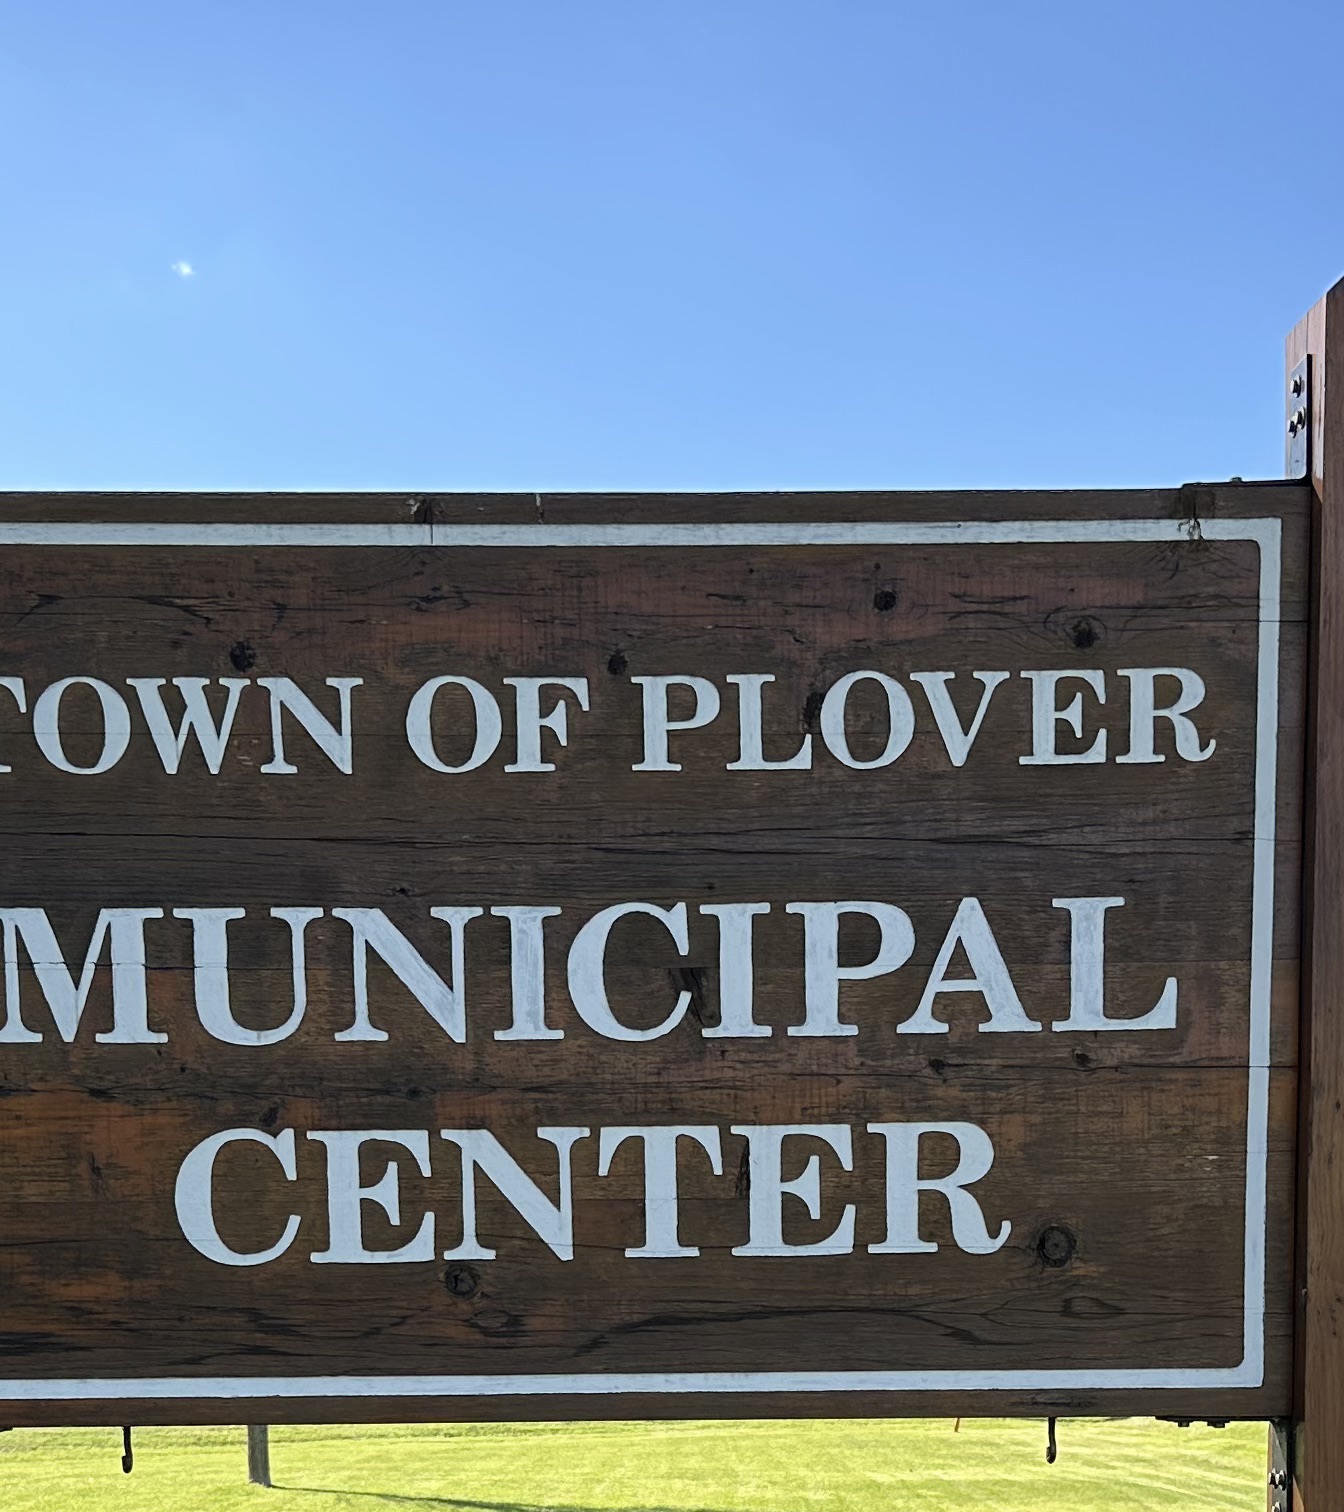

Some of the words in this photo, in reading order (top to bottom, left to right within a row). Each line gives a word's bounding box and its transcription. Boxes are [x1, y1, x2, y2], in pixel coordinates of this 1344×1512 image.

[406, 675, 591, 774] OF
[630, 667, 1218, 772] PLOVER
[174, 1121, 1013, 1267] CENTER
